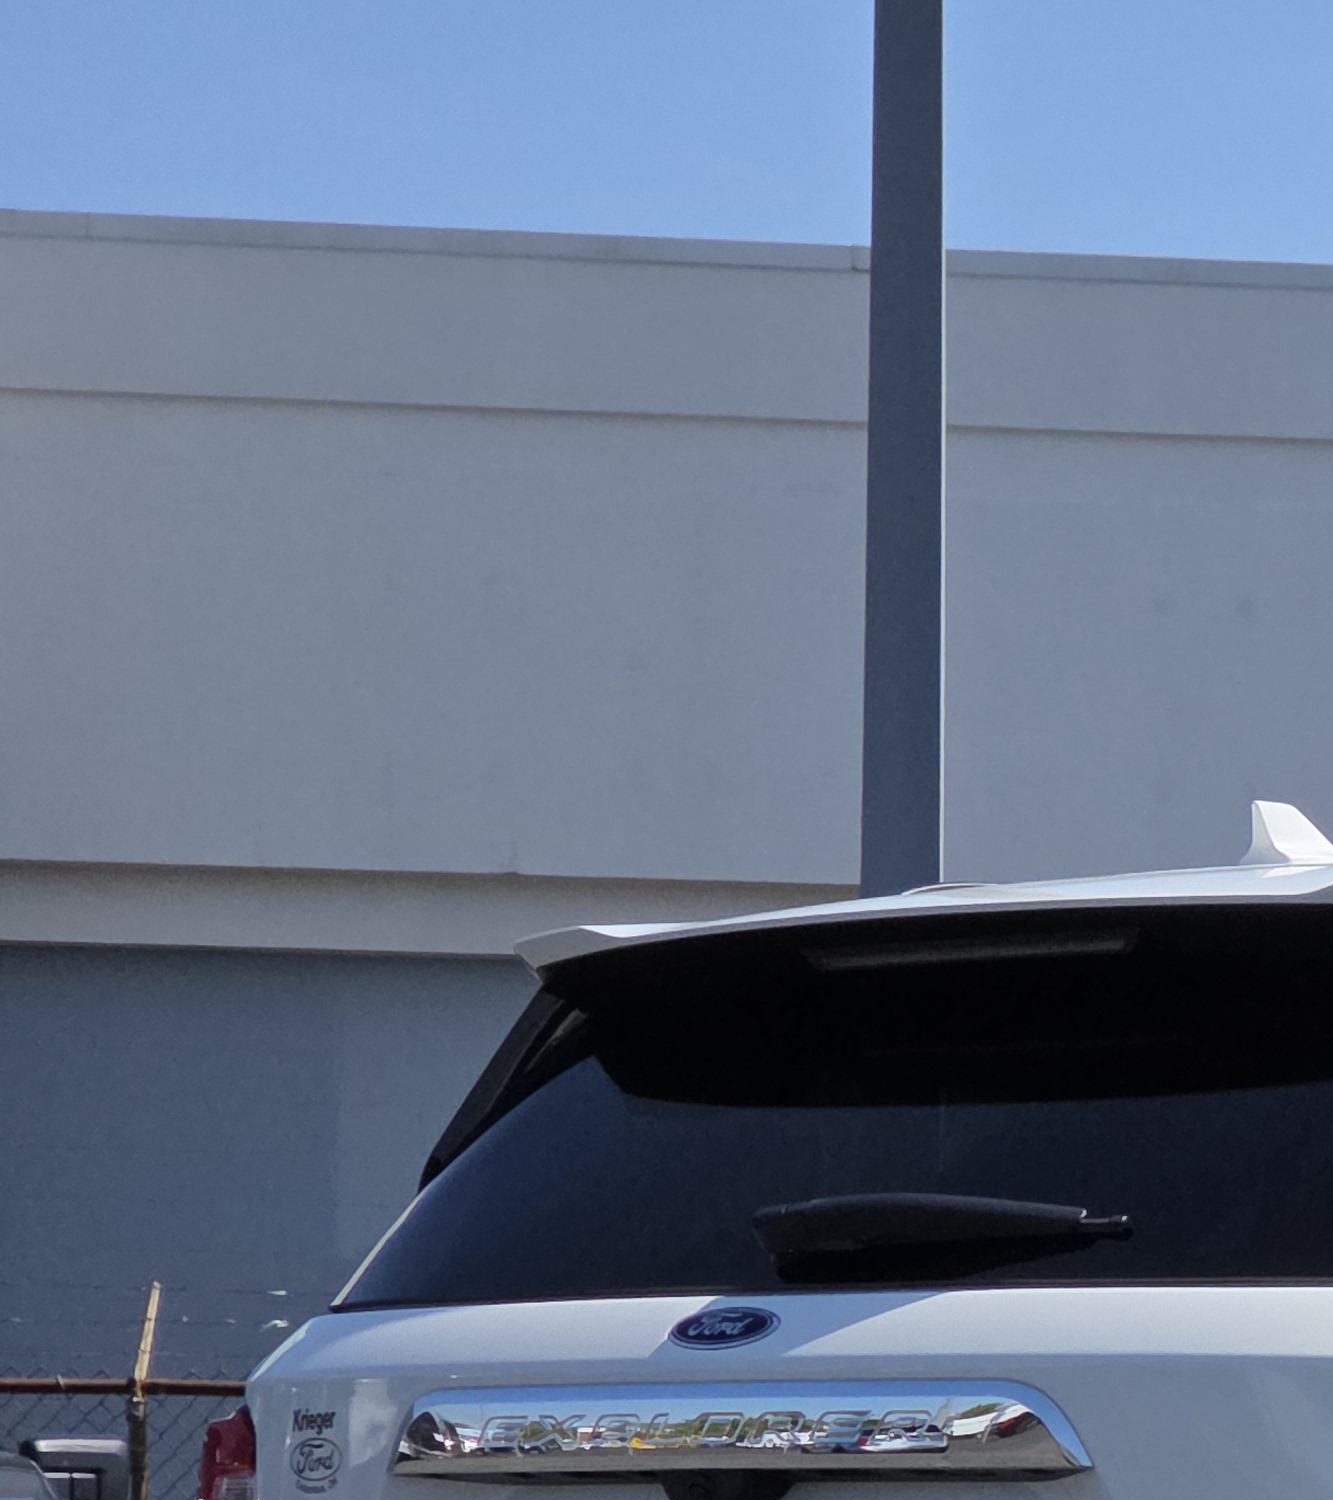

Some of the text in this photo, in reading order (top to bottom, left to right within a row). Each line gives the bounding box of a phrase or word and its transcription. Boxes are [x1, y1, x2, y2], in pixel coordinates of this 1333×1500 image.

[688, 1312, 754, 1336] Ford
[292, 1408, 336, 1435] Krieger
[476, 1410, 945, 1452] EXPLORER
[296, 1443, 335, 1474] Ford
